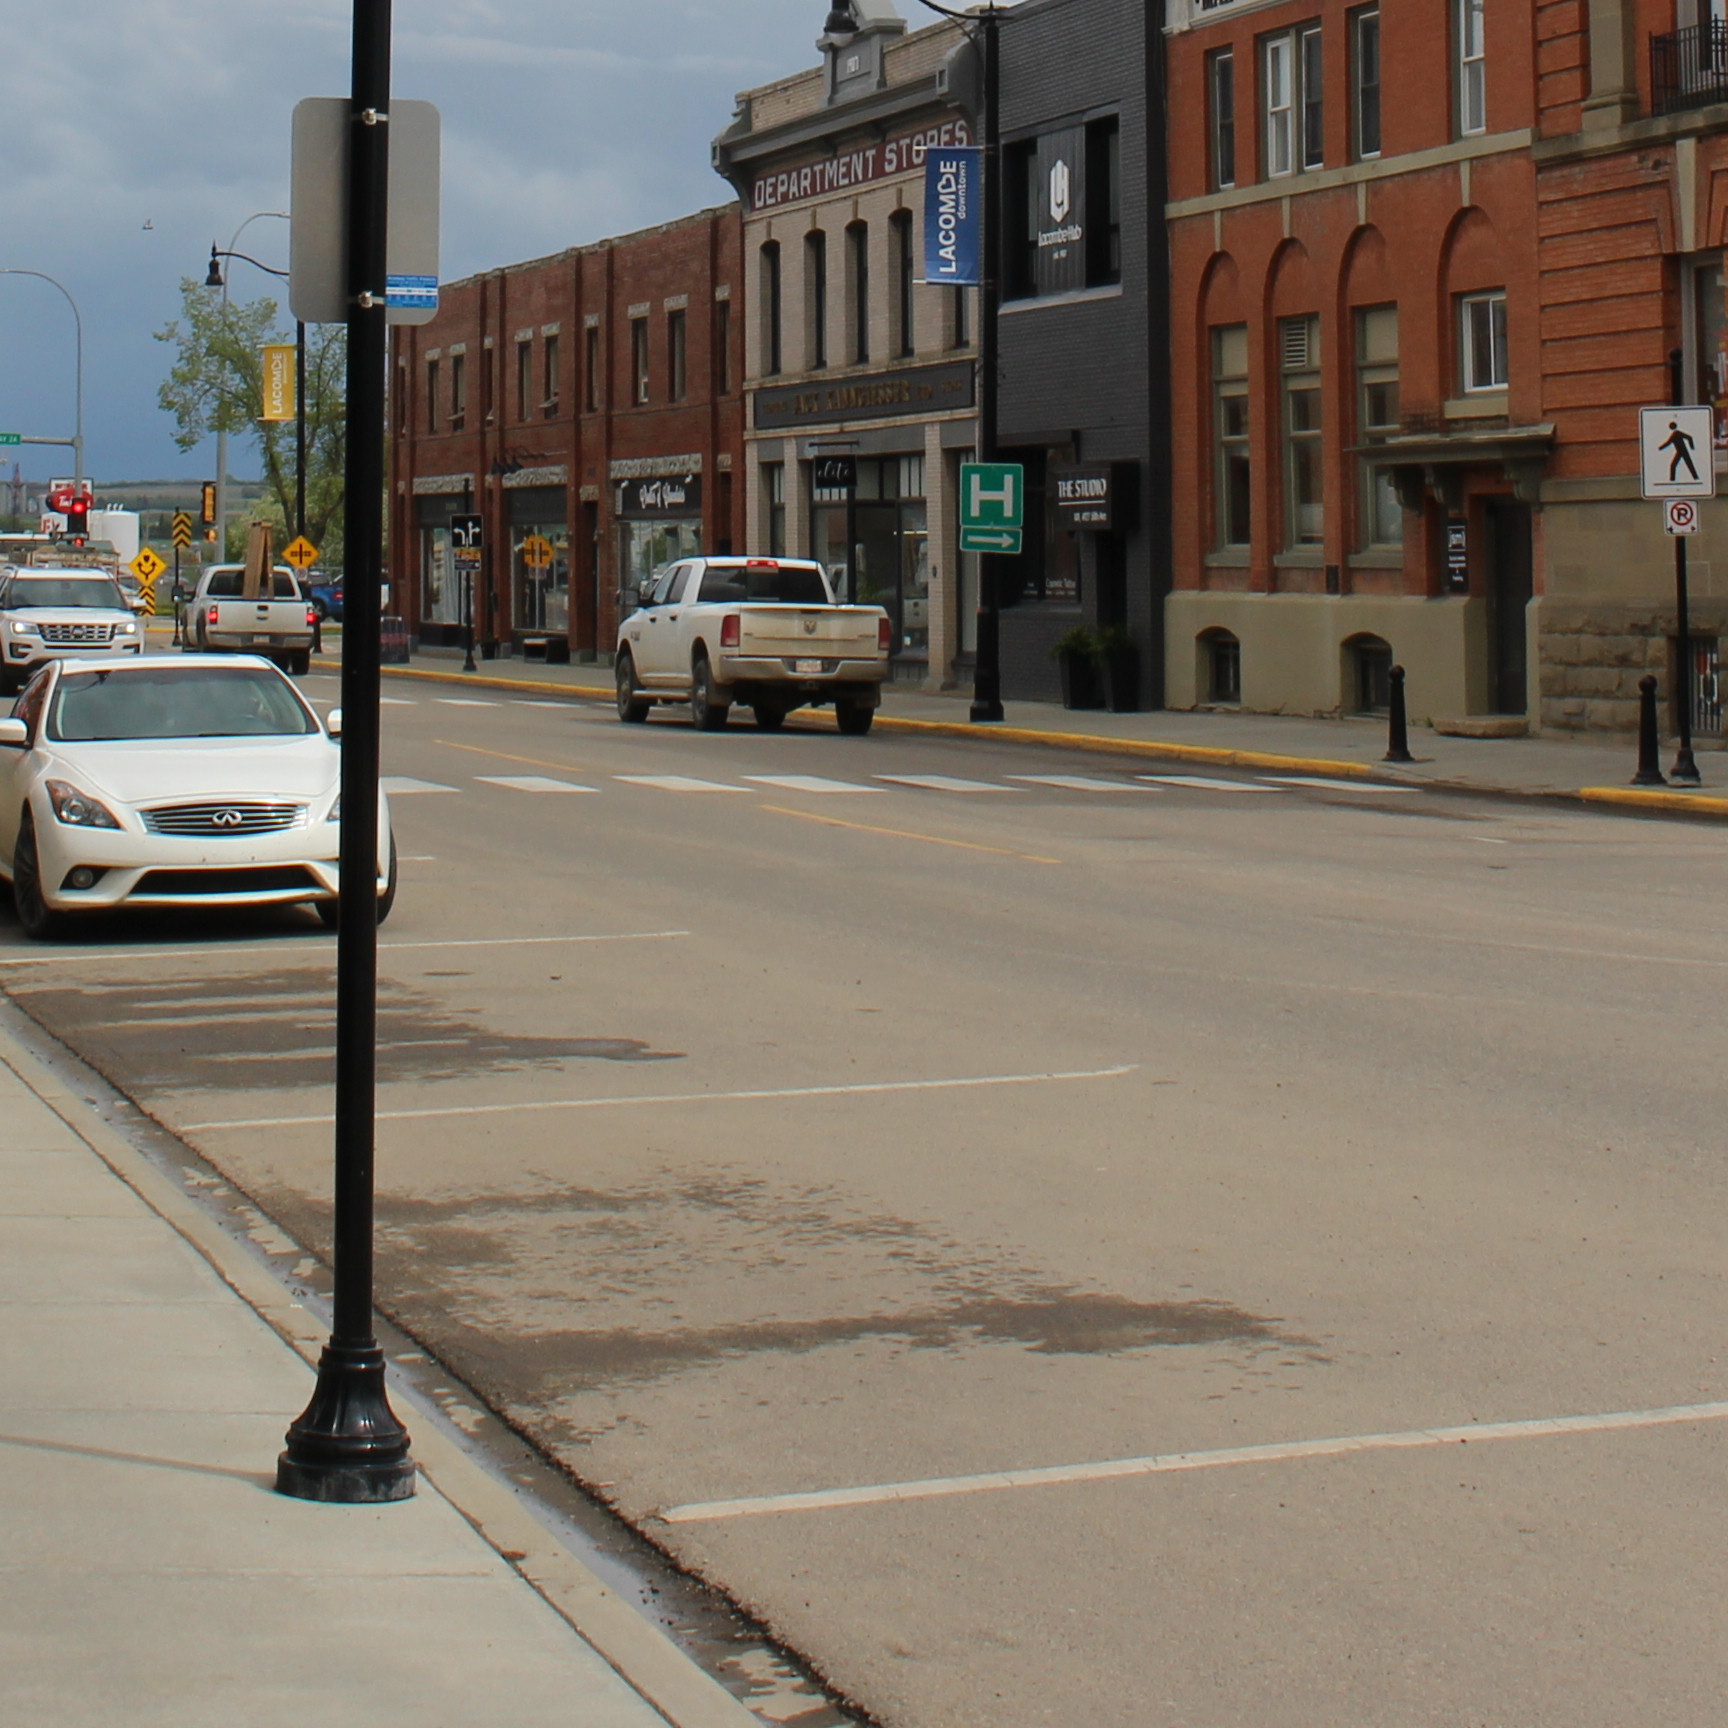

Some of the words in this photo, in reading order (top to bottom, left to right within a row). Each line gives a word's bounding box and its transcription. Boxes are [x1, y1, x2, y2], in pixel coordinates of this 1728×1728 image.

[754, 149, 877, 209] DEPARTMENT
[957, 160, 967, 220] downtown
[970, 474, 1013, 518] H
[1058, 480, 1074, 498] THE
[1075, 478, 1107, 497] STUDIO
